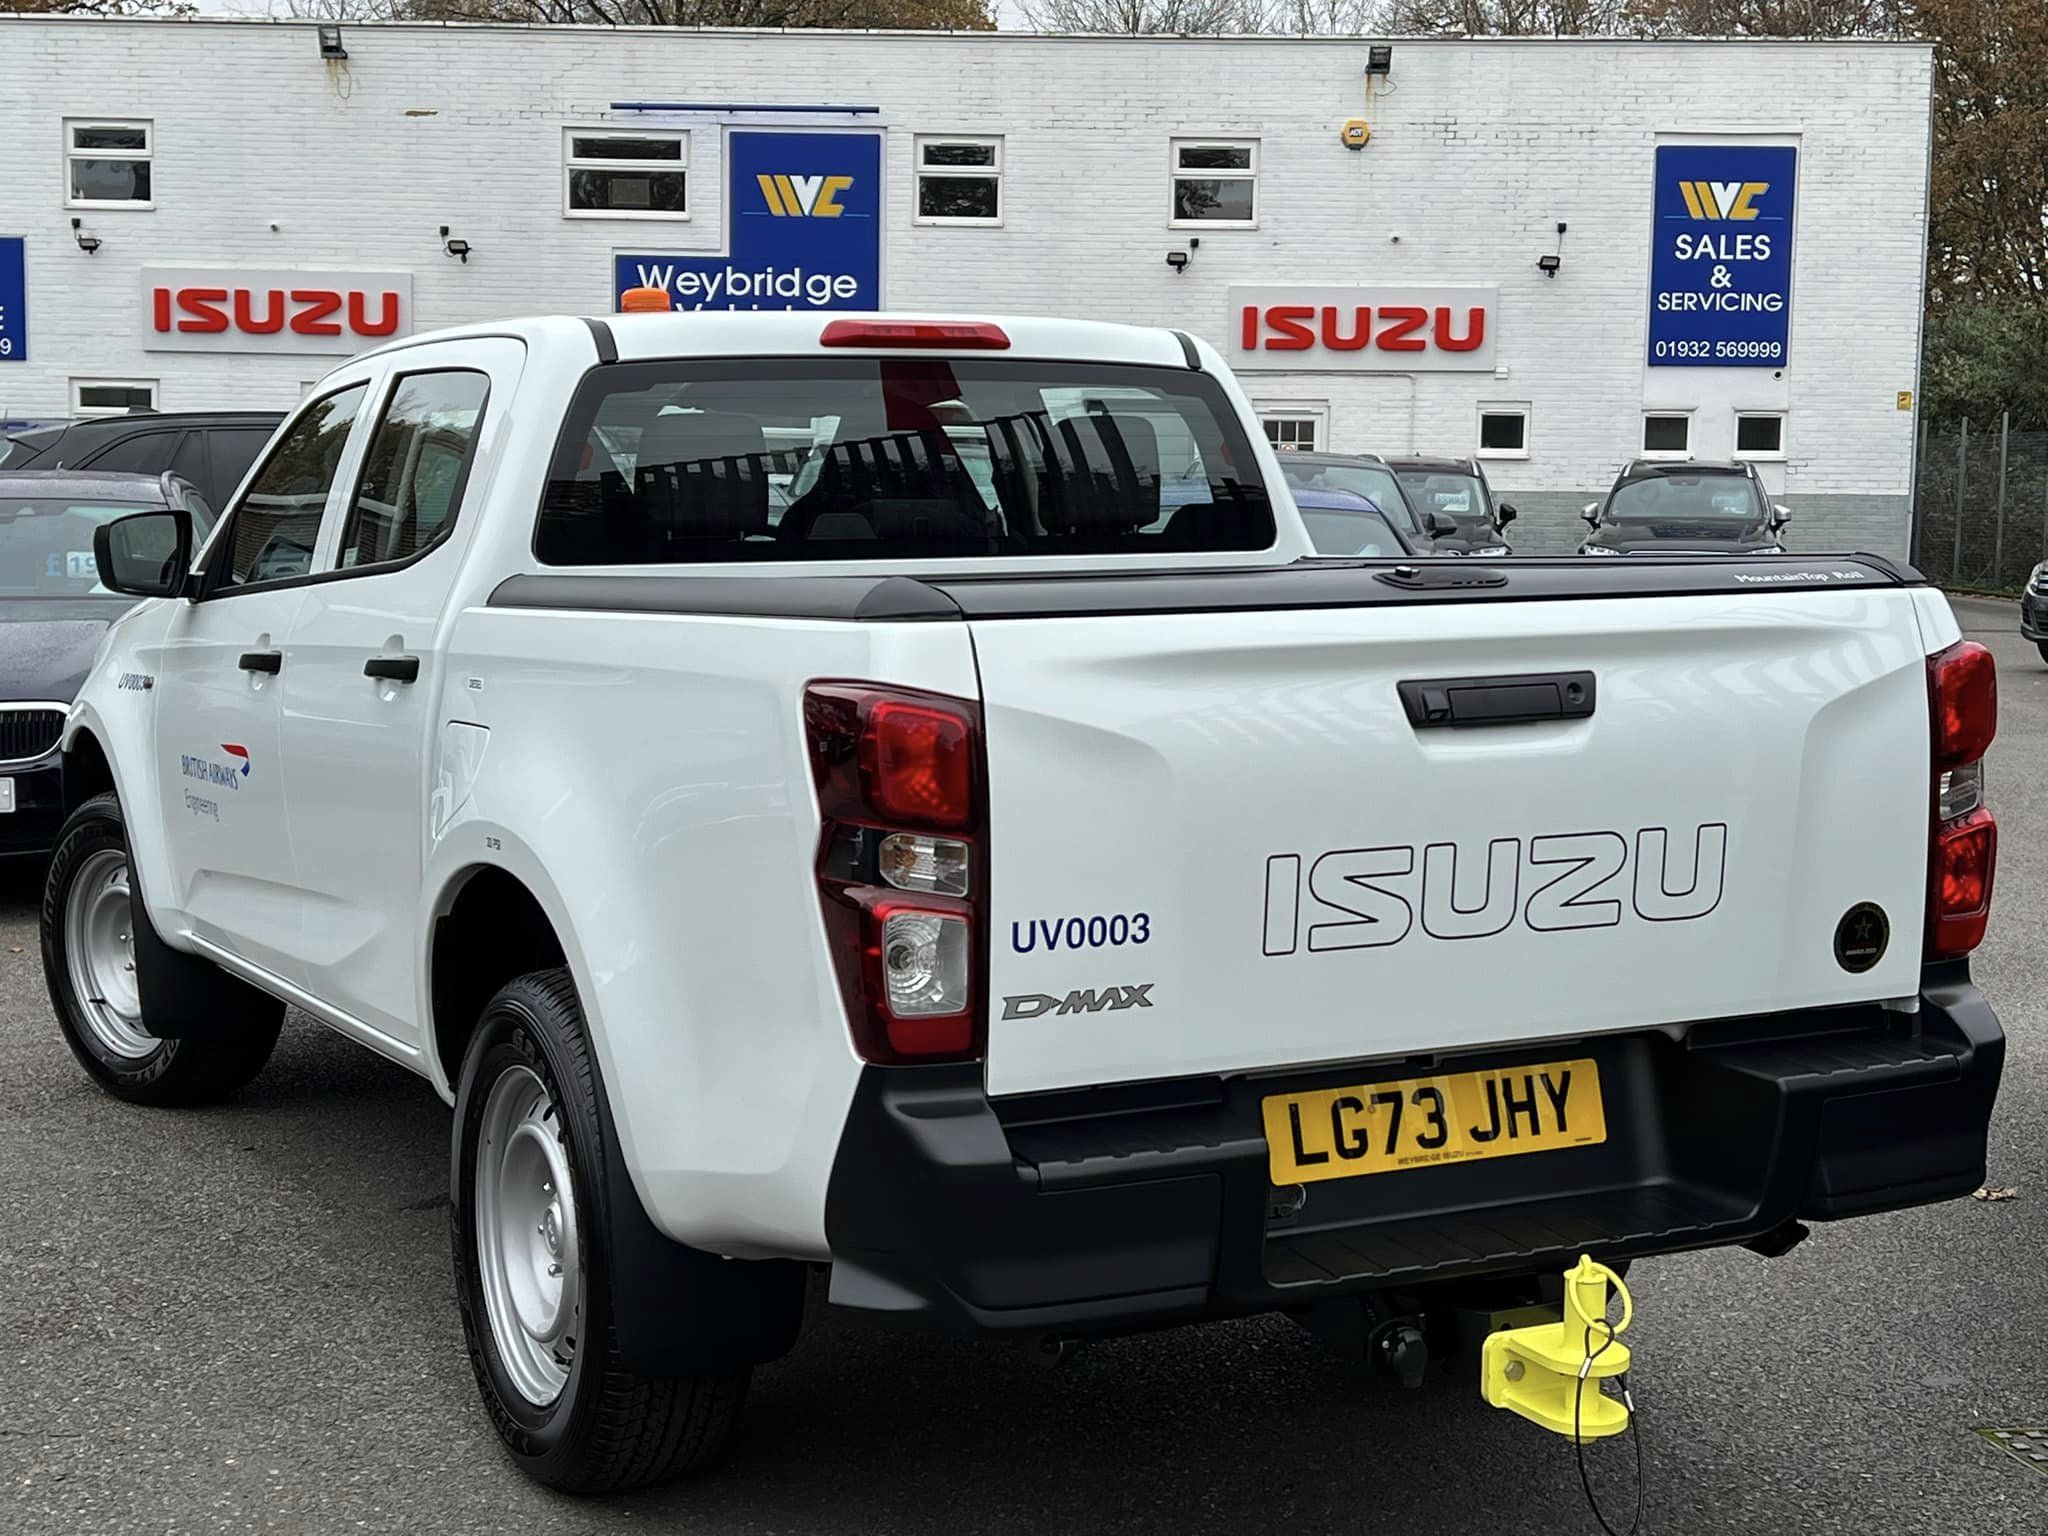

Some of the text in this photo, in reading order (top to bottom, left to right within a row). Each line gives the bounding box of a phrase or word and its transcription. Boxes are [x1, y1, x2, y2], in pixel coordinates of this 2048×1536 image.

[1674, 234, 1771, 261] SALES
[637, 264, 858, 306] Weybridge
[1710, 265, 1733, 289] &
[153, 287, 399, 336] ISUZU
[1657, 292, 1783, 313] SERVICING
[1241, 305, 1485, 352] ISUZU
[1655, 341, 1782, 358] 01932 569999
[1831, 570, 1866, 580] Roll
[1262, 822, 1728, 957] ISUZU
[1011, 912, 1151, 954] UV0003
[1287, 1070, 1572, 1168] LG73 JHY
